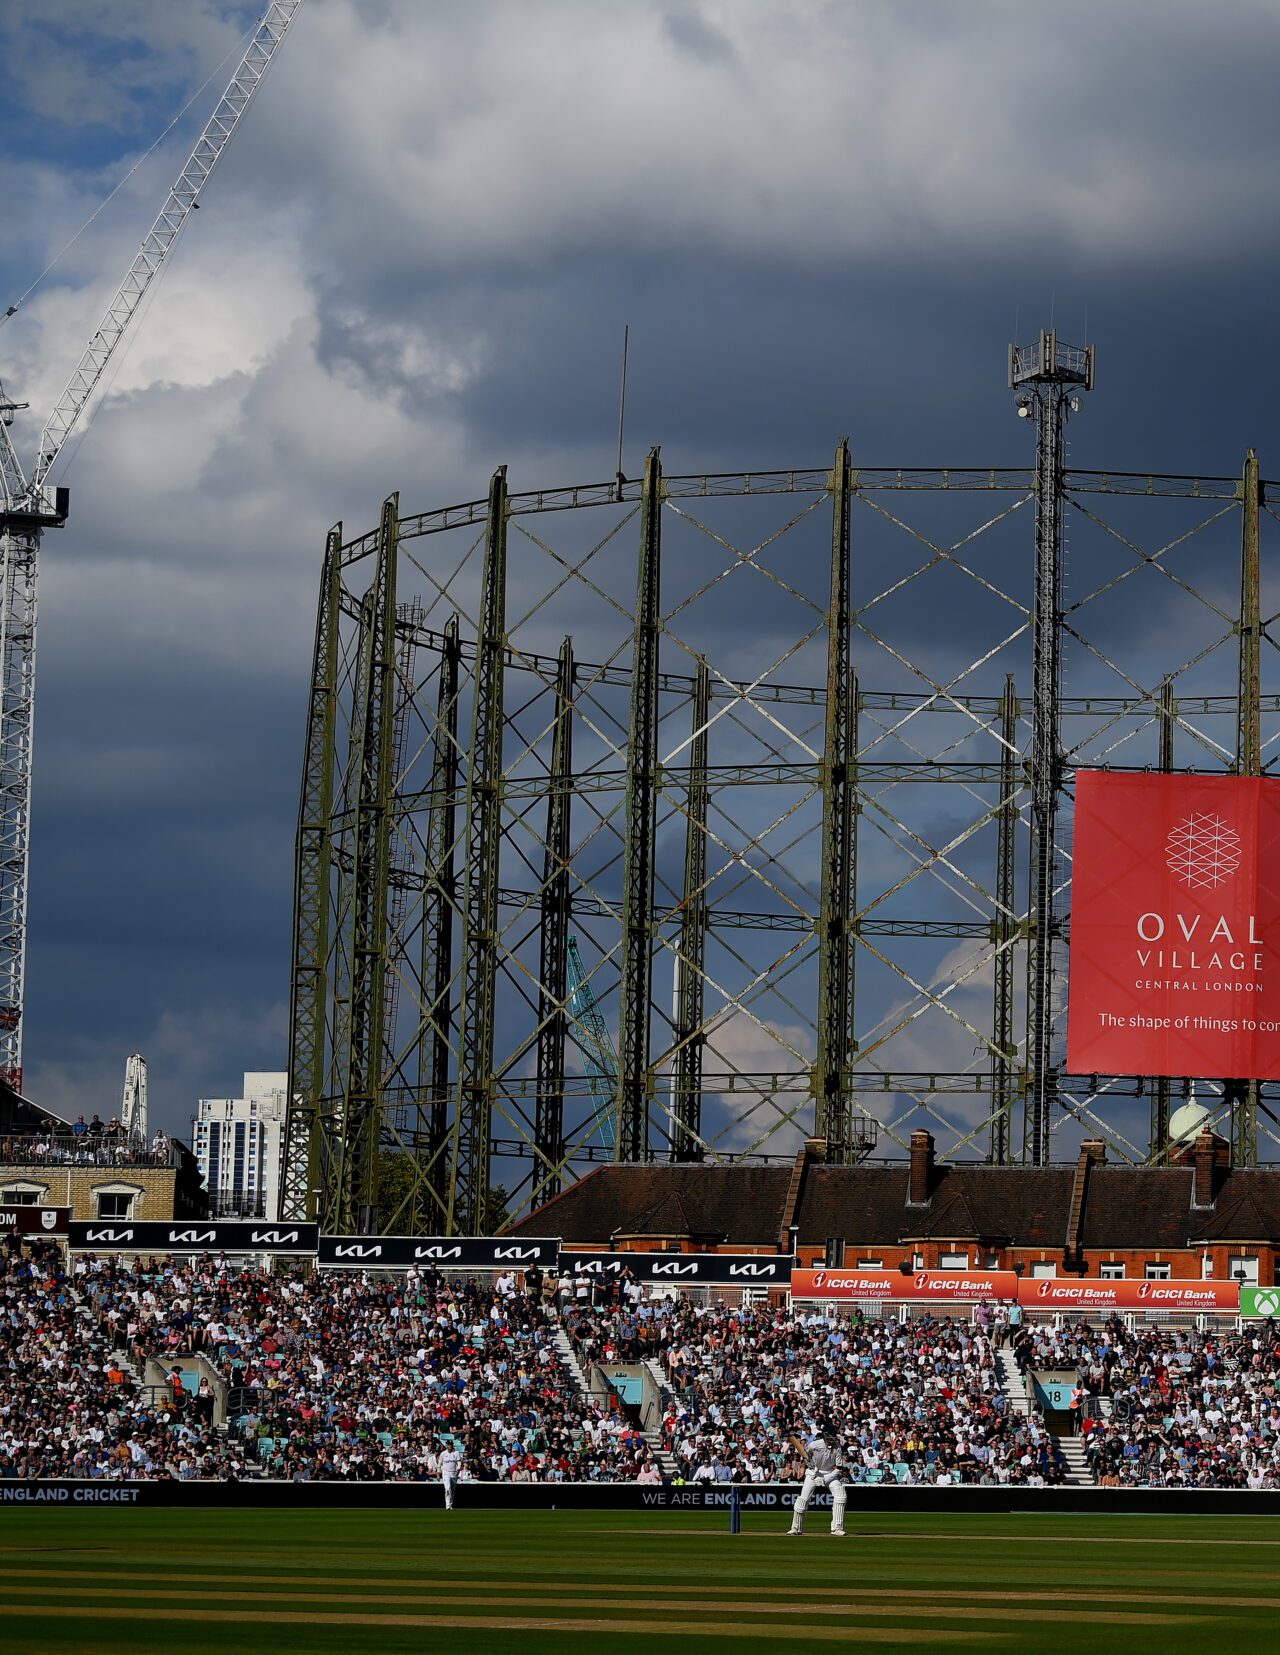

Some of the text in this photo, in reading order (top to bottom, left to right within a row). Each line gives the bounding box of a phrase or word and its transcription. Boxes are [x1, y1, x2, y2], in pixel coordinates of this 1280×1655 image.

[1137, 912, 1264, 944] OVAL
[1136, 950, 1264, 971] VILLAGE
[1135, 980, 1264, 992] CENTRAL LONDON
[1099, 1013, 1125, 1027] The
[1129, 1014, 1171, 1031] shape
[1174, 1015, 1190, 1029] of
[1193, 1016, 1238, 1033] things
[1242, 1018, 1257, 1031] to
[826, 1279, 857, 1288] ICICI
[858, 1280, 892, 1289] Bank
[928, 1280, 960, 1289] ICICI
[960, 1281, 993, 1290] Bank
[1051, 1288, 1083, 1297] ICICI
[1084, 1289, 1117, 1298] Bank
[1151, 1290, 1183, 1299] ICICI
[1184, 1290, 1216, 1299] Bank
[1194, 1300, 1217, 1308] Kingdom
[1048, 1390, 1061, 1402] 18
[73, 1488, 140, 1501] CRICKET
[642, 1493, 667, 1505] WE
[671, 1493, 701, 1505] ARE
